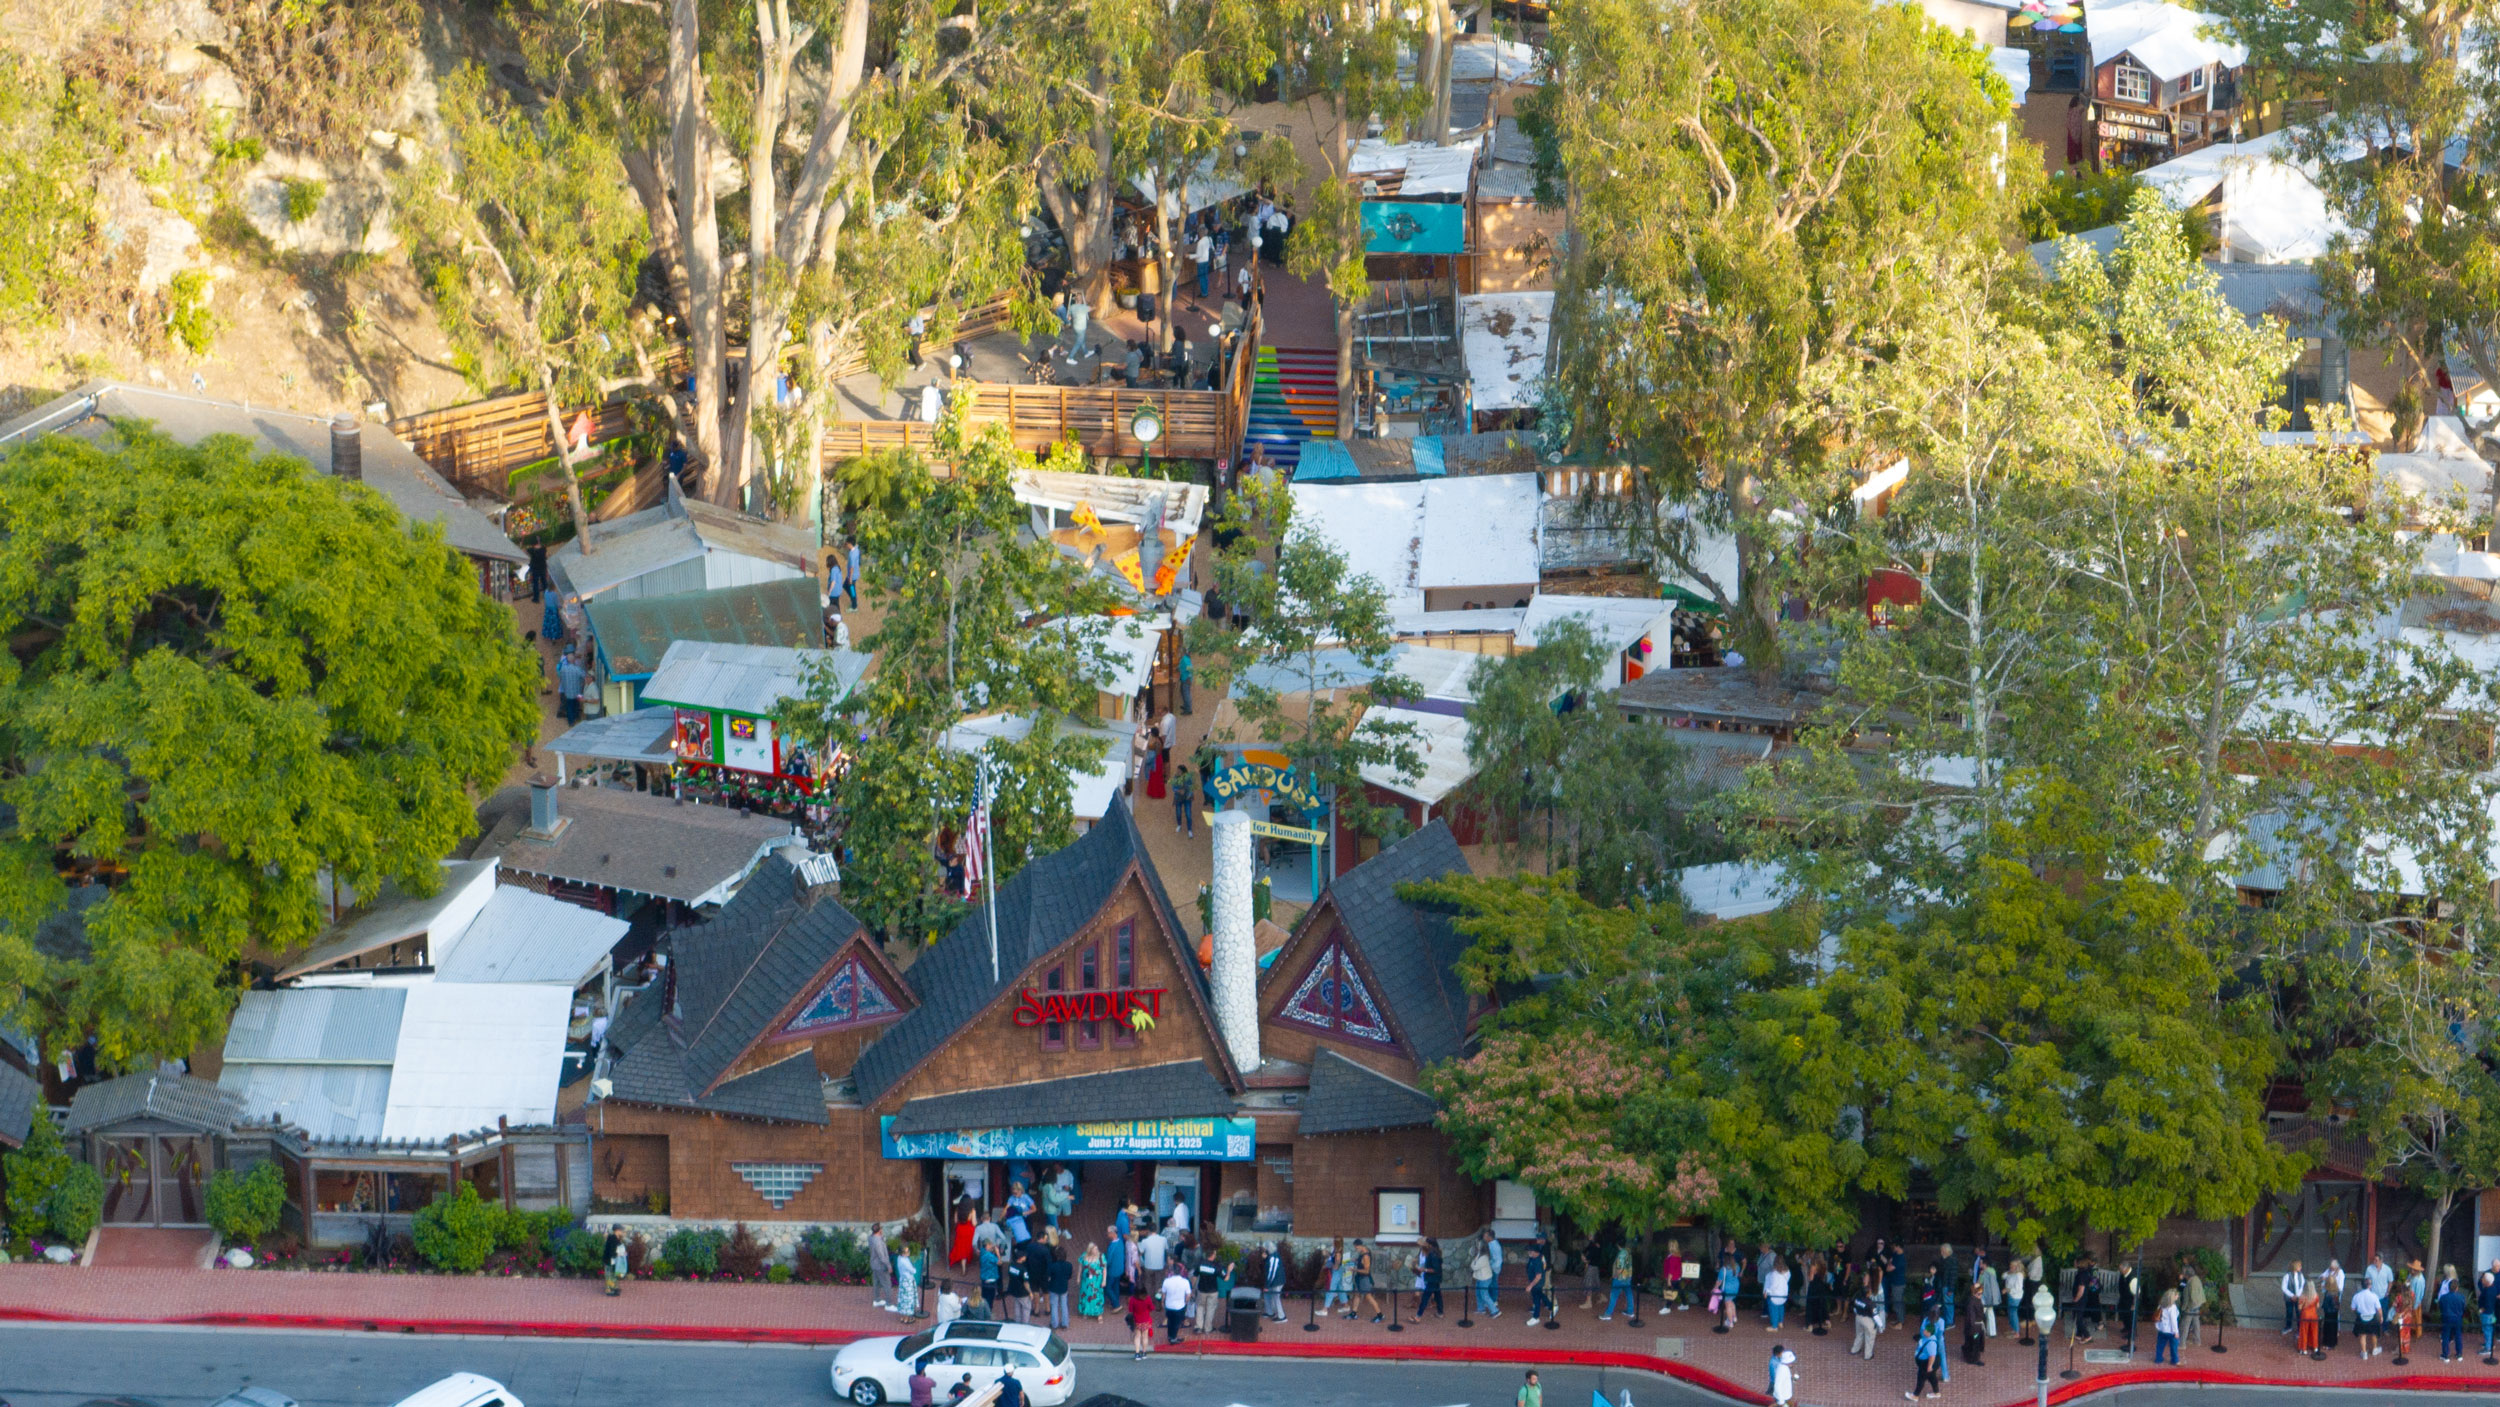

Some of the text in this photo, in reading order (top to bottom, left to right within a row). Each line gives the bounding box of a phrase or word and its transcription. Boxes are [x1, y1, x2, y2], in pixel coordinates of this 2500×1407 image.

[2111, 111, 2157, 127] LAGUNA
[2098, 121, 2169, 145] SUNSHINE
[1253, 822, 1318, 843] for Humanity
[1013, 987, 1169, 1029] SAWDUST
[1076, 1120, 1214, 1137] Sawdust Art Festival
[1088, 1137, 1112, 1149] June
[1163, 1137, 1177, 1149] 31,
[1178, 1137, 1202, 1149] 2025
